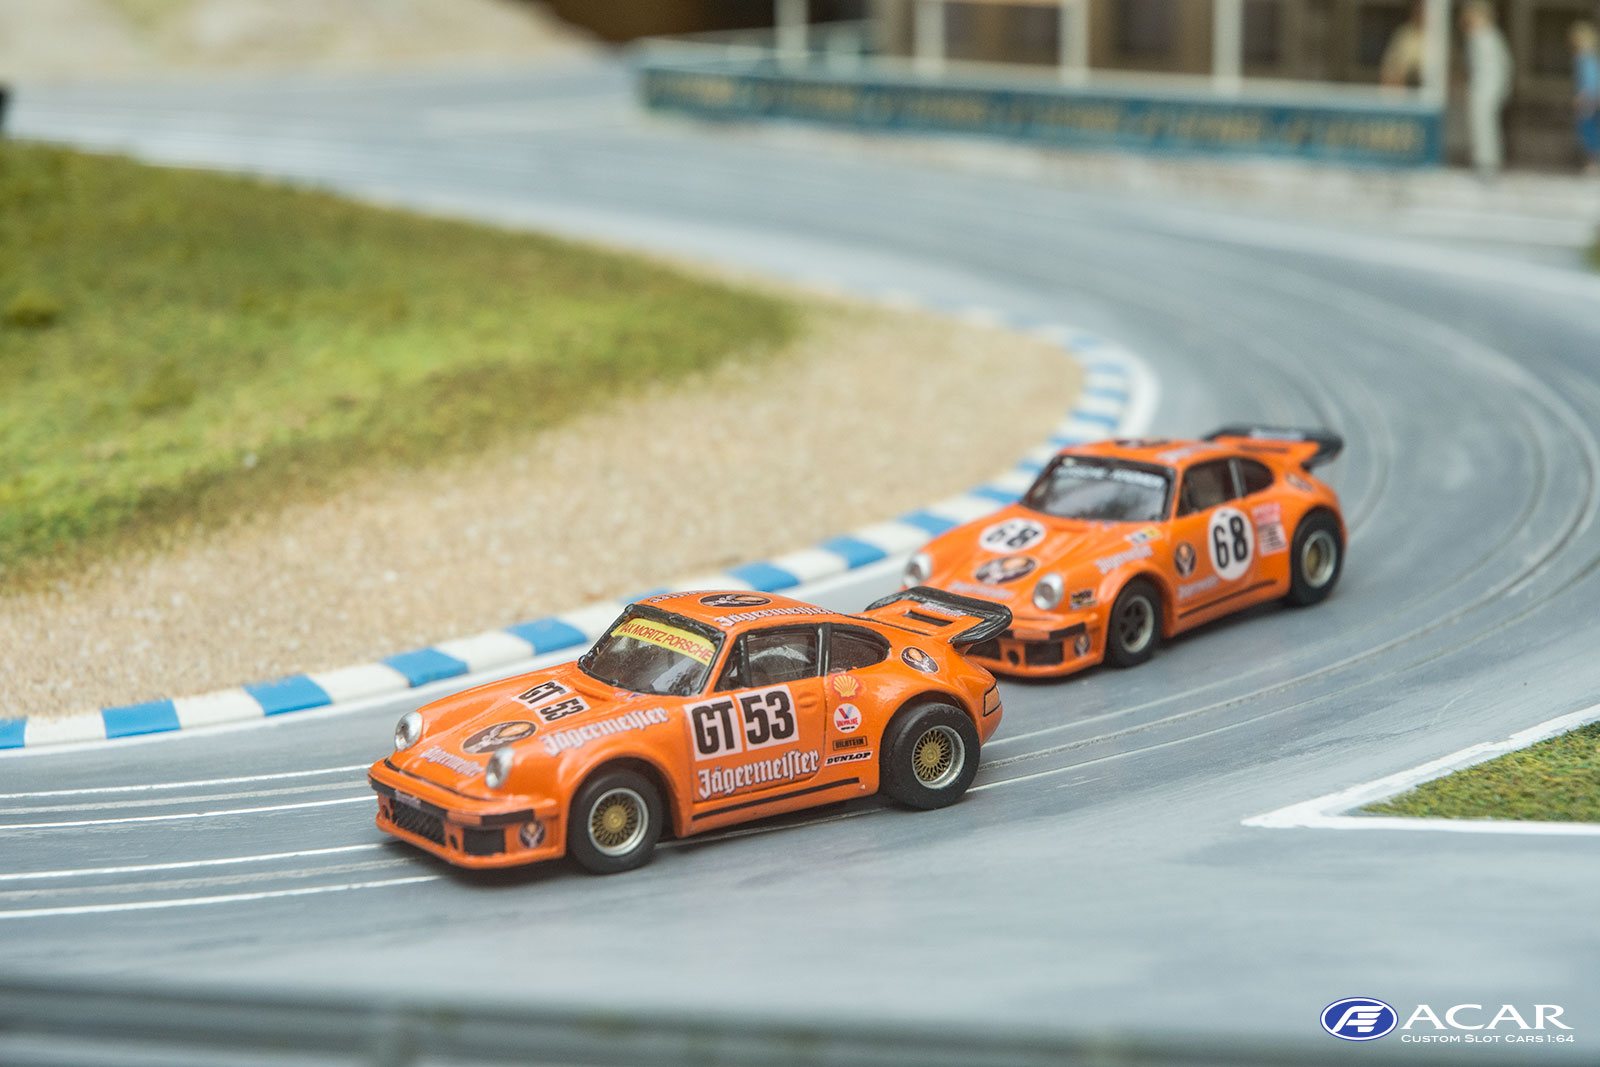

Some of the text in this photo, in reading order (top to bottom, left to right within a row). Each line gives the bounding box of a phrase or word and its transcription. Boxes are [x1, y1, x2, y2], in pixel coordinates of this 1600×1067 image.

[1213, 515, 1249, 569] 68
[633, 624, 668, 642] MORITZ
[663, 633, 714, 662] PORSCHE
[518, 681, 566, 704] GT
[540, 698, 584, 721] 53
[691, 700, 735, 755] GT
[739, 690, 795, 744] 53
[826, 752, 871, 764] DUNLOP
